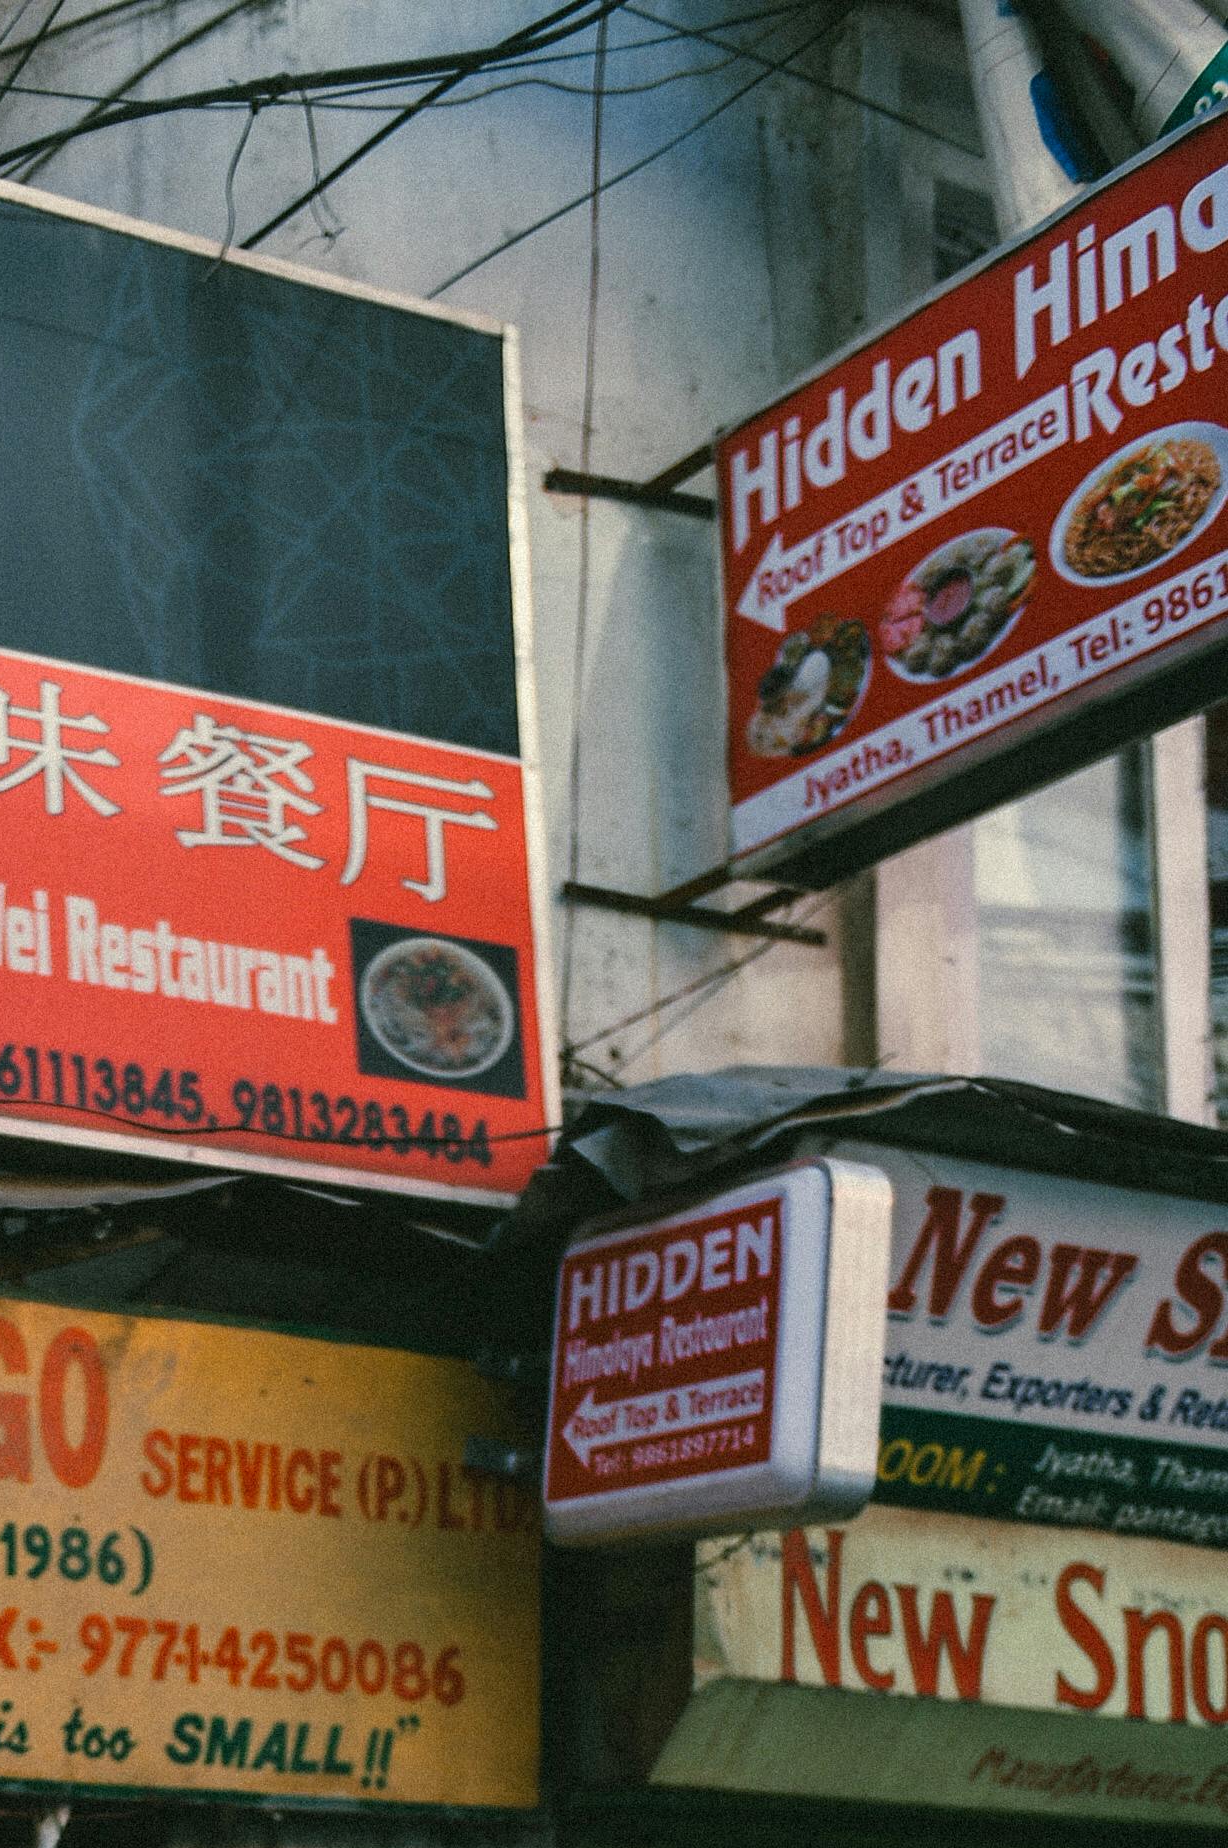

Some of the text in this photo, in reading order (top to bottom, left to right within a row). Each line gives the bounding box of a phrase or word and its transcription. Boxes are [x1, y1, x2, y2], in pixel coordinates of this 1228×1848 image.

[728, 328, 981, 556] Hidden
[755, 409, 1060, 612] Roof Top & Terrace
[802, 735, 915, 808] Jyatha,
[921, 654, 1062, 745] Thamel,
[1069, 617, 1134, 670] Tel:
[65, 895, 338, 1025] Restaurant
[569, 1215, 773, 1331] HIDDEN
[886, 1185, 1228, 1361] New S
[981, 1362, 1133, 1420] Exporters
[1140, 1383, 1166, 1422] &
[139, 1427, 344, 1519] SERVICE
[879, 1438, 1009, 1494] OOM:
[781, 1527, 997, 1701] New
[62, 1706, 139, 1763] too
